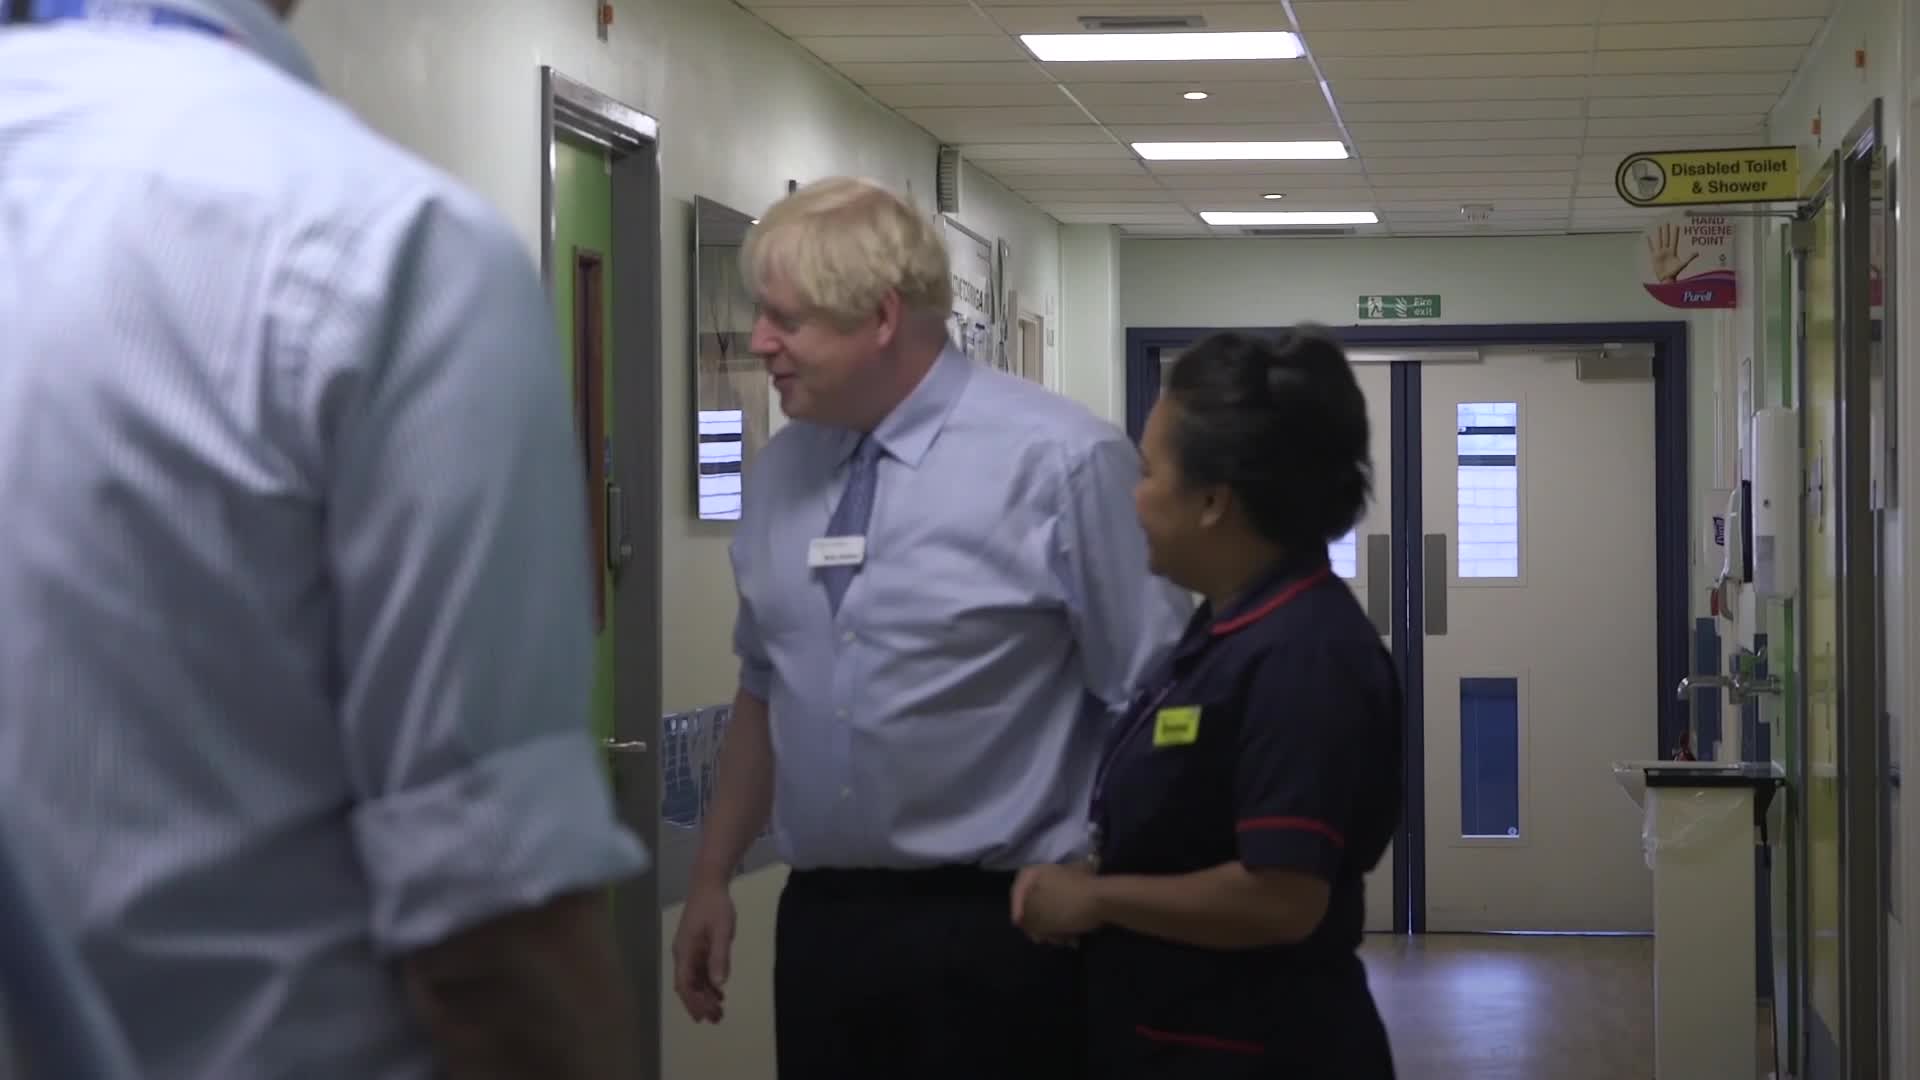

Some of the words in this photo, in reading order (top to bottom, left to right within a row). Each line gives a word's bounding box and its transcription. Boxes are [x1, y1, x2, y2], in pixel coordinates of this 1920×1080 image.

[1671, 161, 1740, 176] Disabled
[1745, 159, 1787, 173] Toilet
[1692, 182, 1703, 194] &
[1708, 180, 1767, 194] Shower
[1691, 215, 1725, 224] HAND
[1684, 225, 1734, 235] HYGIENE
[1691, 236, 1724, 246] POINT
[1414, 297, 1432, 306] Fire
[1684, 291, 1712, 303] Purell
[1414, 307, 1432, 316] exit
